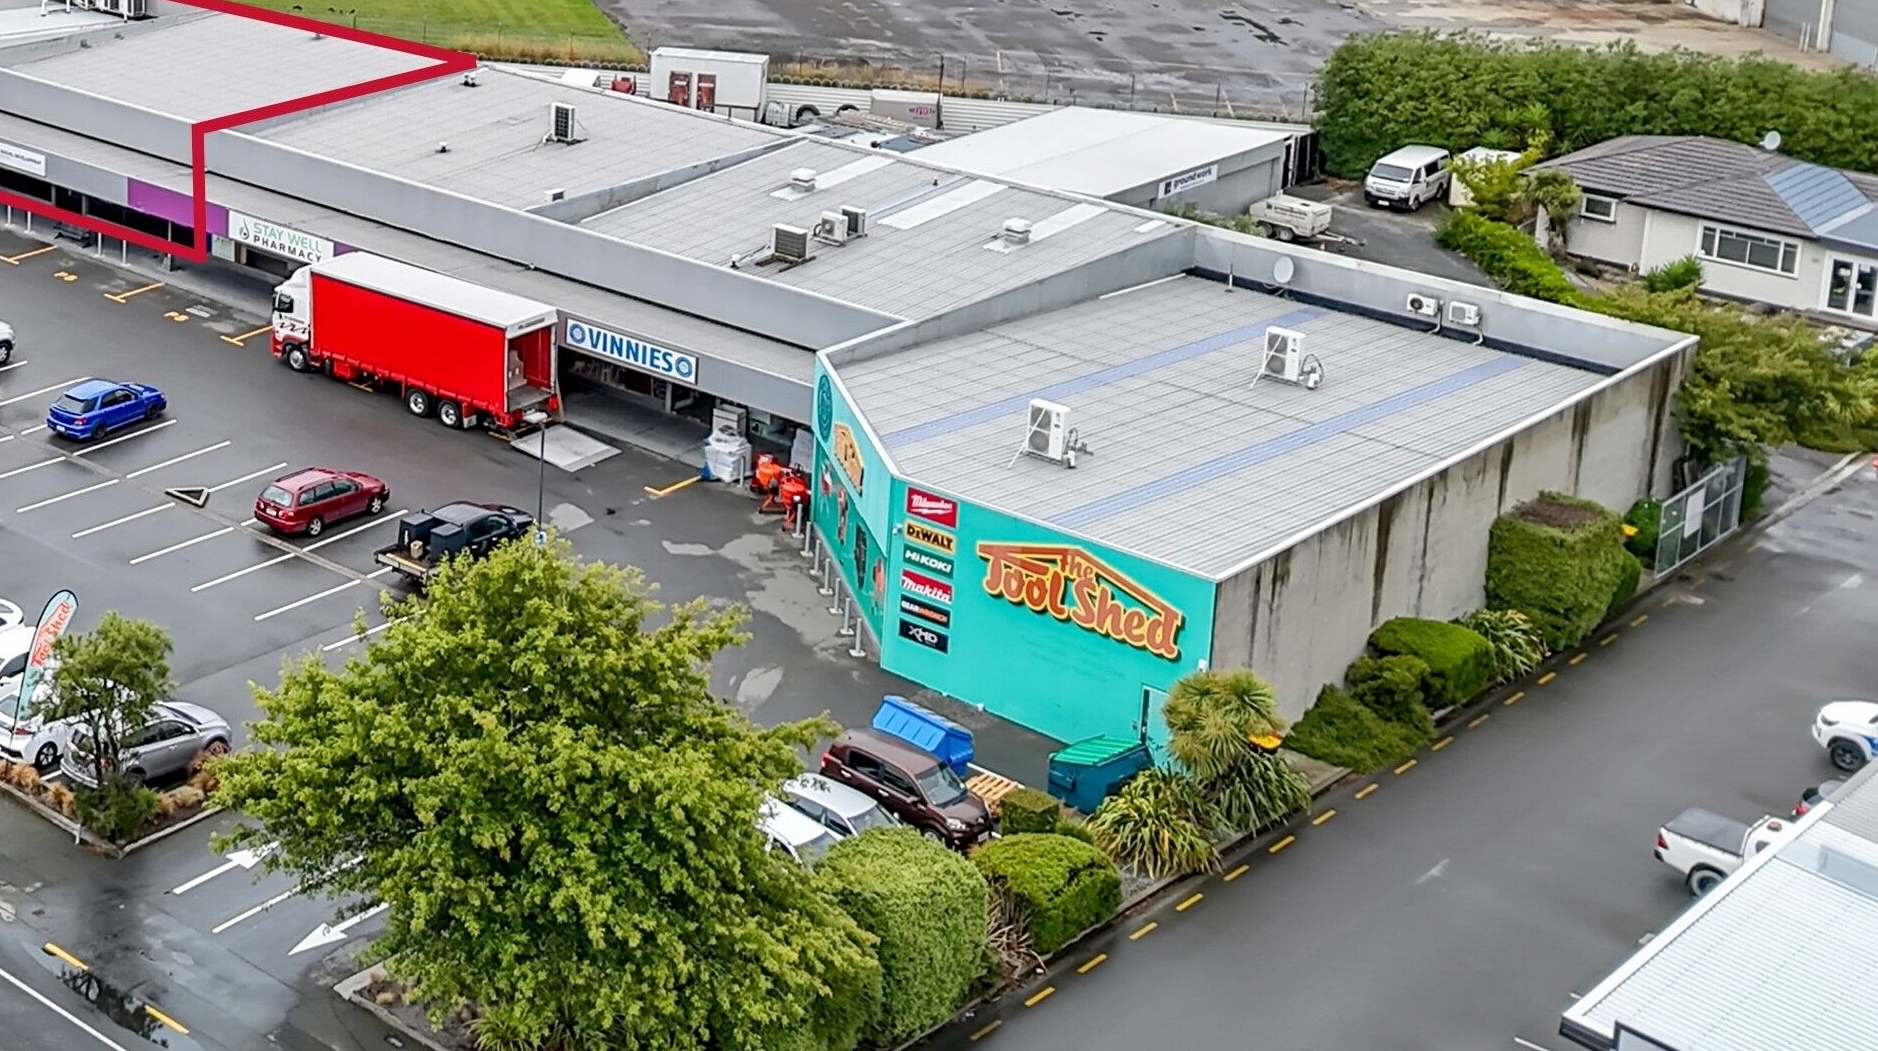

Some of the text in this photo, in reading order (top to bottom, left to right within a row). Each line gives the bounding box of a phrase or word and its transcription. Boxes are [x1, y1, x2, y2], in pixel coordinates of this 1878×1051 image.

[253, 222, 322, 254] STAY WELL
[253, 235, 322, 263] PHARMACY
[588, 328, 673, 373] VINNIES
[978, 545, 1067, 619] Tool
[1070, 578, 1182, 659] Shed
